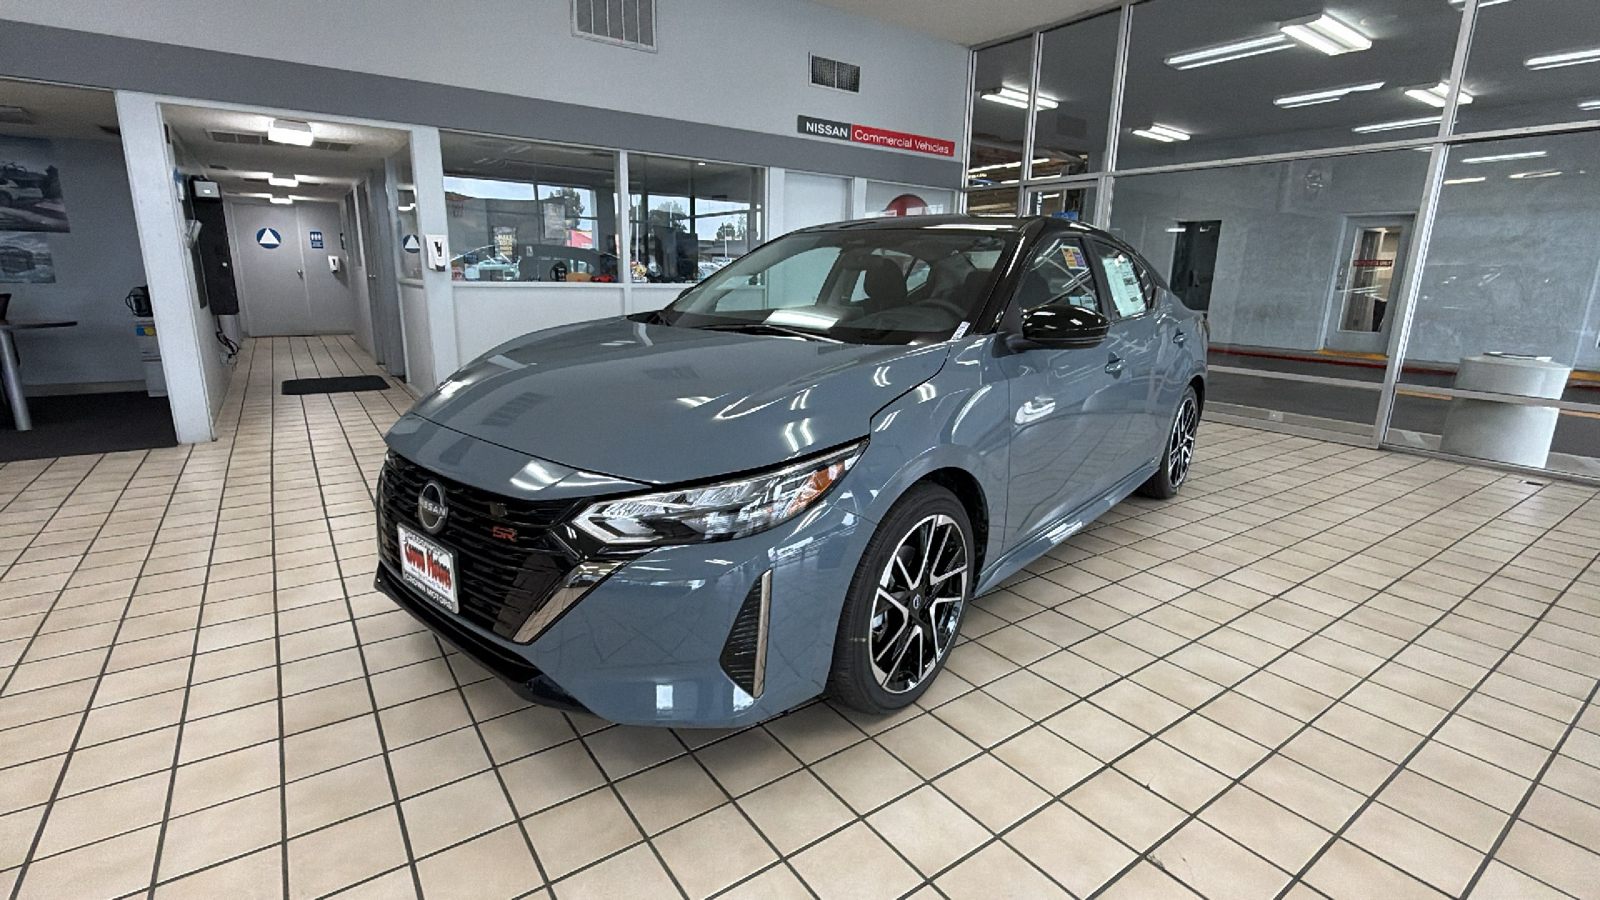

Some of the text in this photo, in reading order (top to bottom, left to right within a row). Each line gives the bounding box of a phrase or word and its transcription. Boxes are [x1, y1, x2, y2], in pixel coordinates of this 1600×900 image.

[806, 121, 848, 137] NISSAN
[854, 129, 949, 154] Commercial Vehicles
[492, 525, 517, 542] SR
